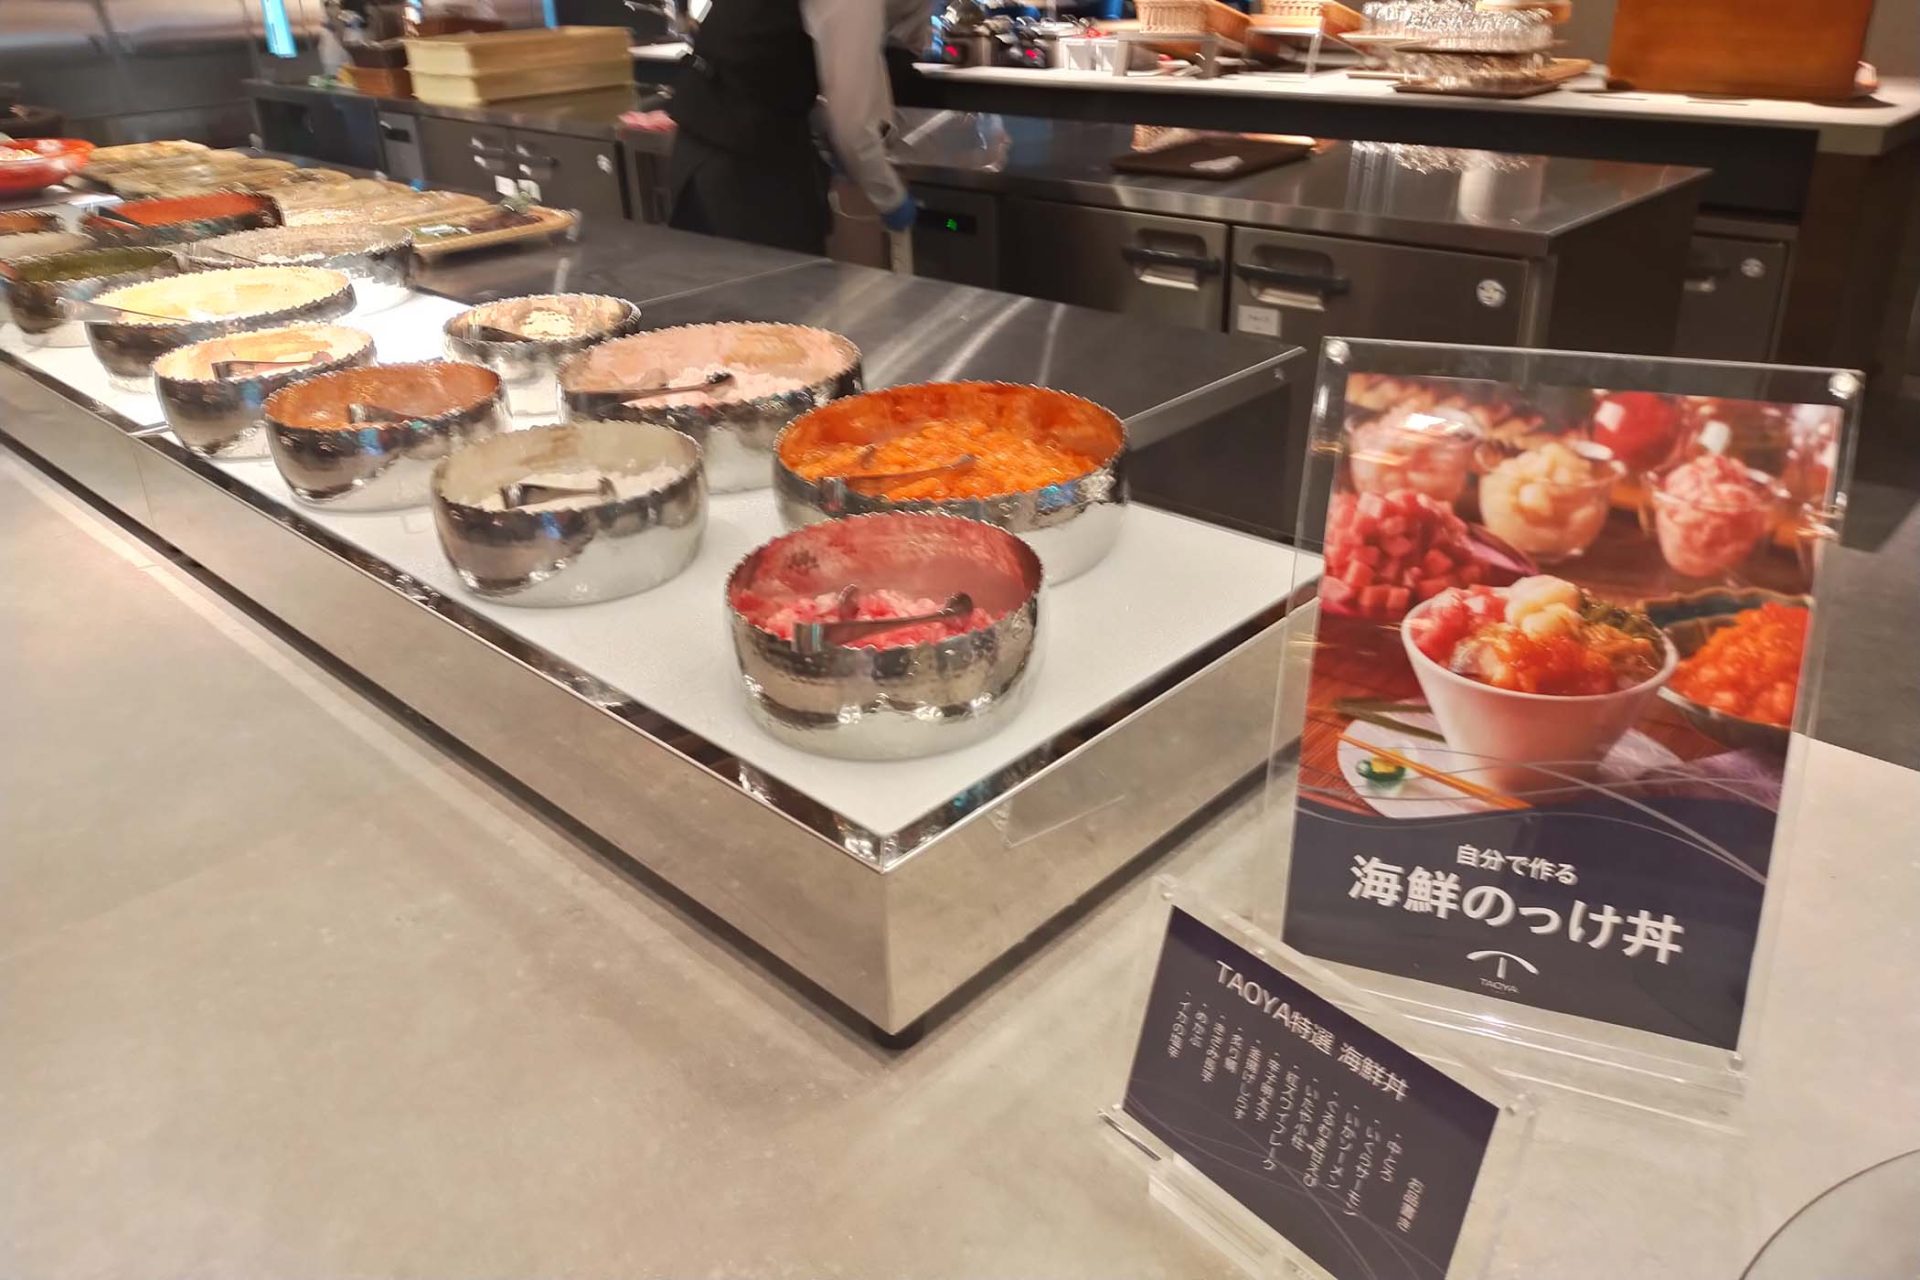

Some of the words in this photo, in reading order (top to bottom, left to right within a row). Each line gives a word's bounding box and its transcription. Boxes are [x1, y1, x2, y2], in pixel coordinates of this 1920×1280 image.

[1456, 844, 1579, 886] 自分で作る
[1349, 855, 1685, 965] 海鮮のっけ丼
[1479, 976, 1520, 994] TAOYA
[1216, 961, 1335, 1056] TAOYA特選
[1338, 1043, 1410, 1101] 海鮮丼
[1397, 1178, 1424, 1232] お品書き
